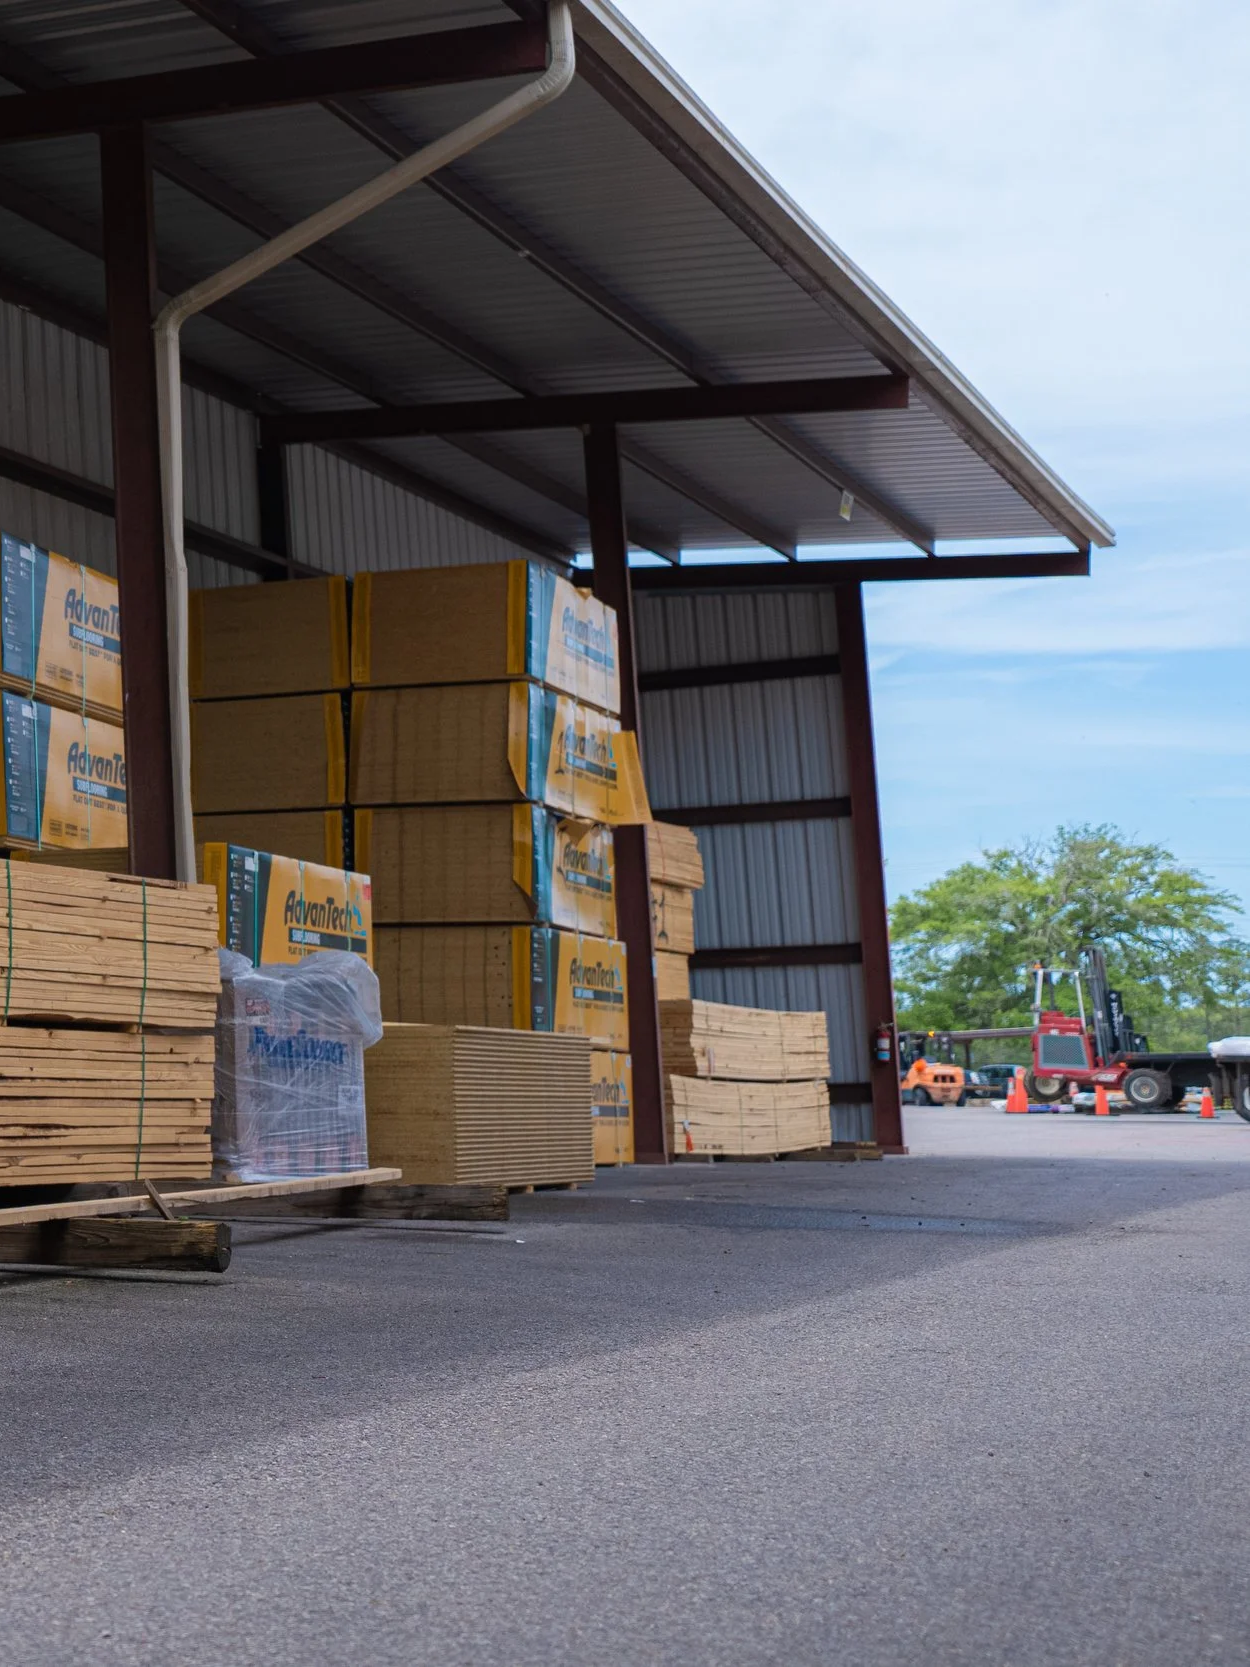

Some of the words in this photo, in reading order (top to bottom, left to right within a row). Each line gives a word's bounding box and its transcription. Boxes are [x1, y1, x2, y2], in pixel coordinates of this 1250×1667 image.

[64, 588, 120, 635] AdvanT
[67, 742, 126, 785] AdvanTe
[284, 890, 352, 932] AdvanTech
